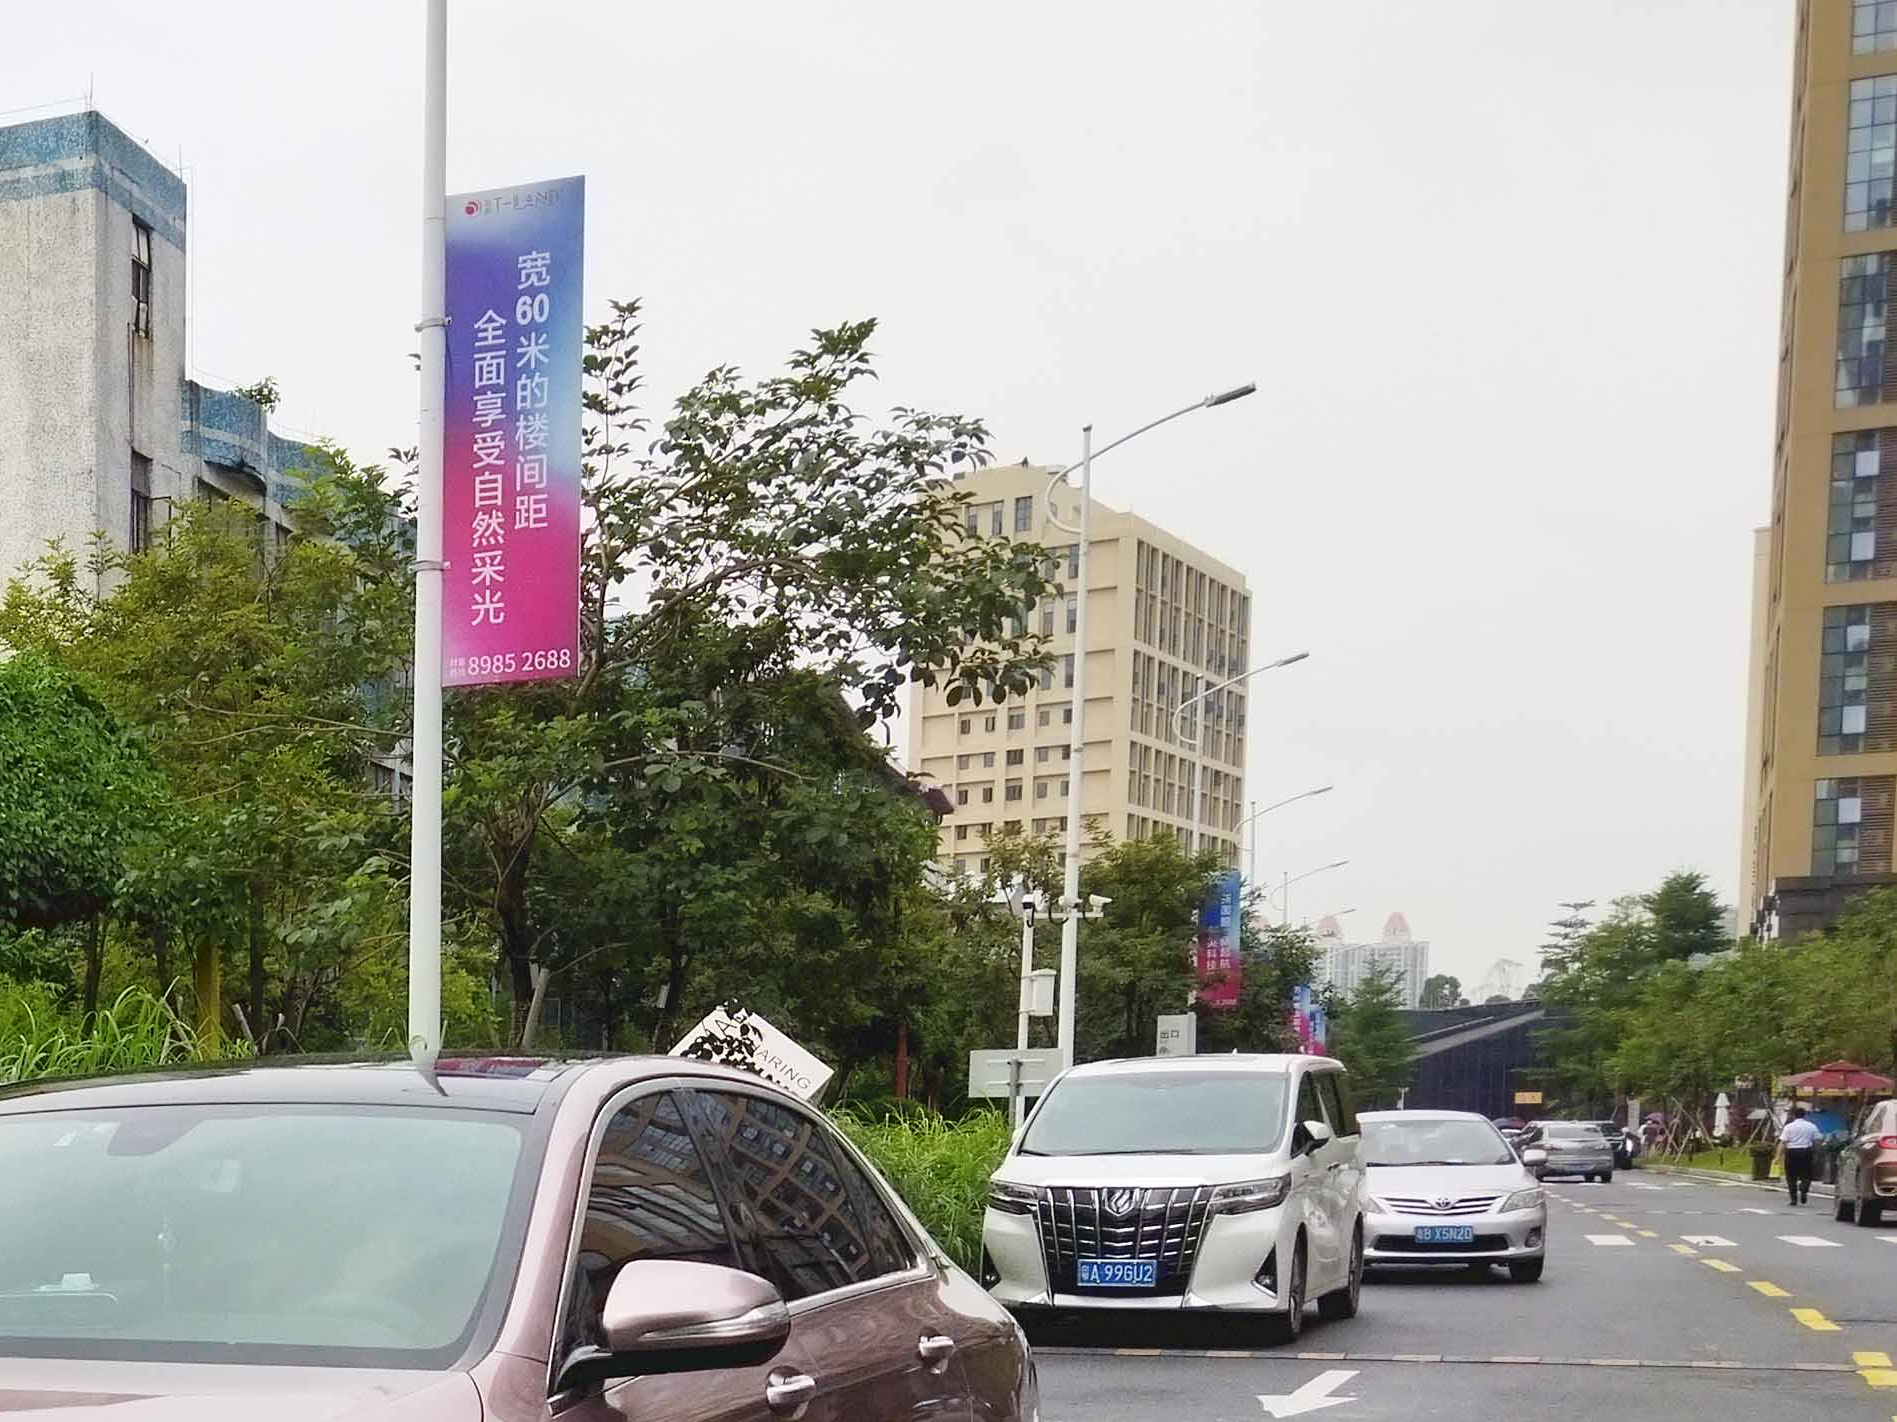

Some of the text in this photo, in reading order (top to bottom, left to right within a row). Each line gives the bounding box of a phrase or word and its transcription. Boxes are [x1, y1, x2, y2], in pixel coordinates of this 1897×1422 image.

[471, 308, 507, 626] 全面享受自然采光
[514, 250, 551, 529] 宽60米的楼间距
[468, 654, 516, 675] 8985
[522, 648, 571, 671] 2688
